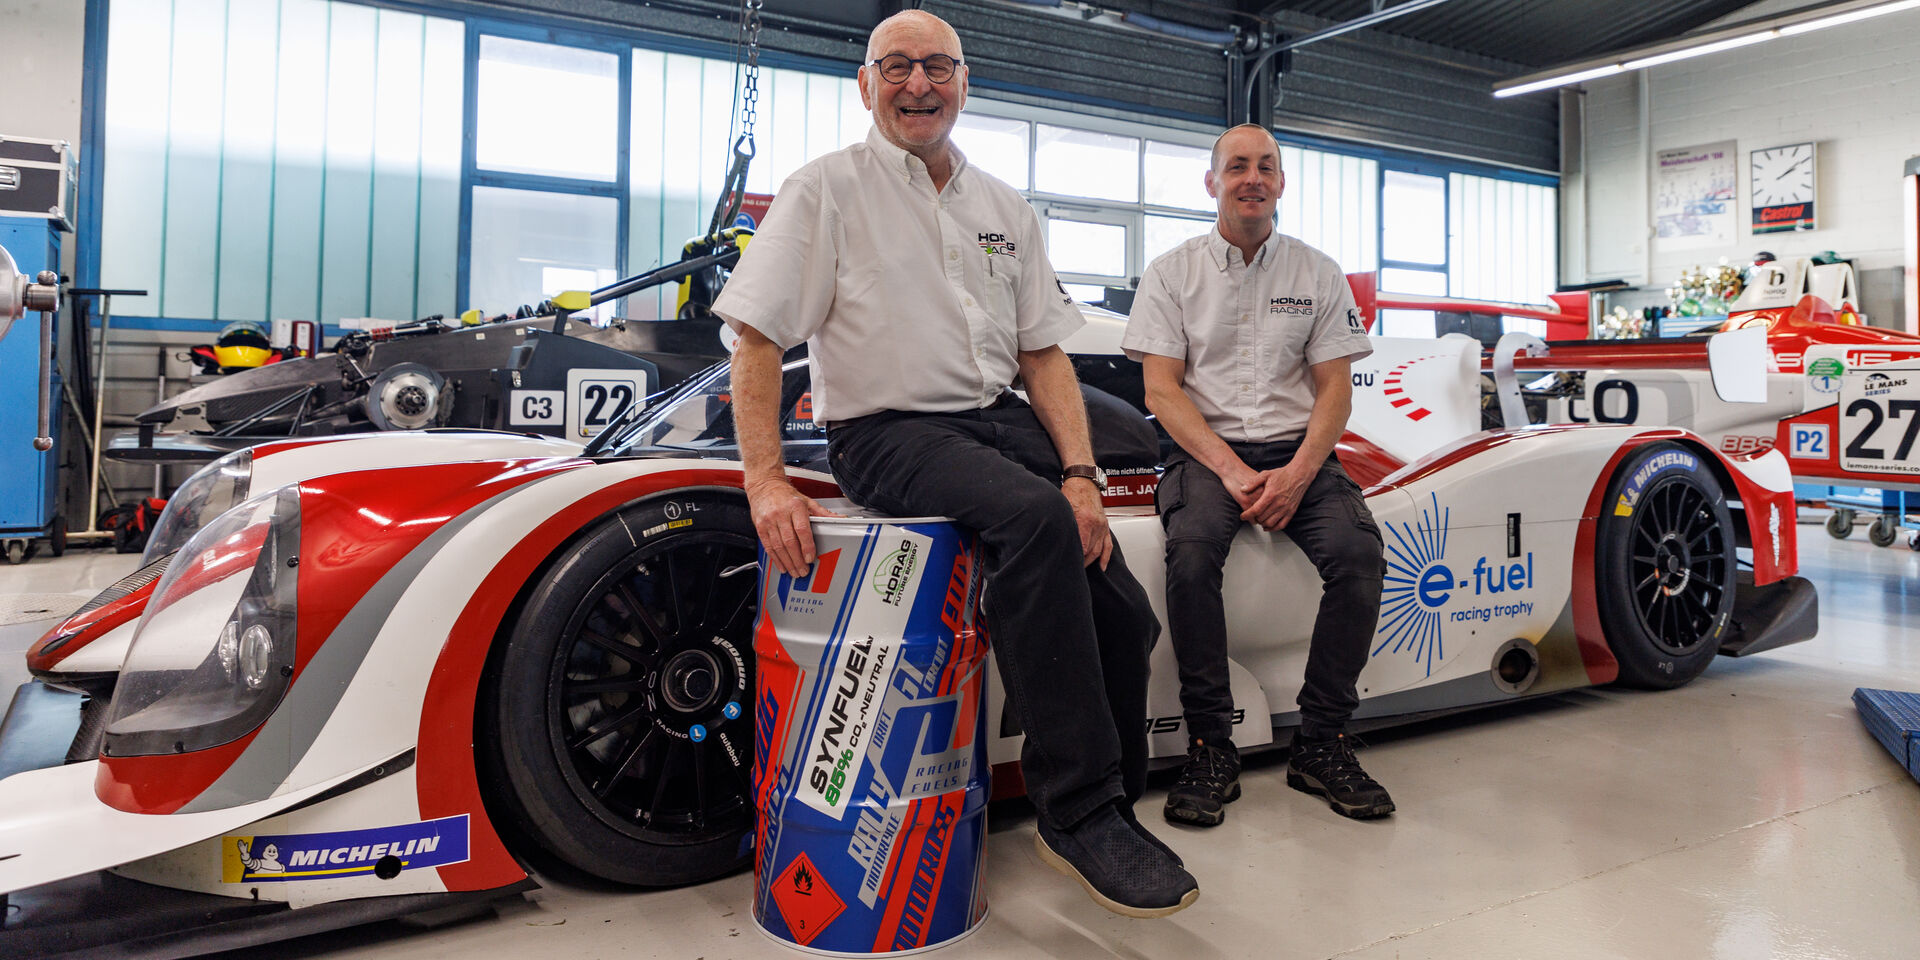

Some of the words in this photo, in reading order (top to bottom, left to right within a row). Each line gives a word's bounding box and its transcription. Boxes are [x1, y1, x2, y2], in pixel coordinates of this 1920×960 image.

[1760, 204, 1804, 221] Castrol
[978, 233, 1016, 251] HORG
[1270, 297, 1313, 306] HORAG
[1270, 307, 1313, 316] RACING
[1864, 383, 1874, 391] LE
[1878, 379, 1908, 389] MANS
[1865, 388, 1891, 397] SERIES
[522, 396, 553, 419] C3
[584, 384, 633, 426] 22
[1845, 398, 1920, 461] 27
[1720, 434, 1776, 455] BBS
[1795, 430, 1824, 453] P2
[1105, 468, 1120, 476] Bitte
[1120, 467, 1136, 475] nicht
[1634, 452, 1693, 488] MICHELIN
[1846, 462, 1920, 472] lemans-series.co
[685, 502, 700, 512] FL
[882, 539, 911, 604] HORAG
[894, 576, 908, 607] FUTURE
[905, 543, 919, 575] ENERGY
[1419, 552, 1533, 607] e-fuel
[1450, 606, 1491, 622] racing
[1494, 600, 1534, 618] trophy
[923, 635, 948, 694] CIRCUIT
[810, 634, 874, 795] SYNFUEL
[656, 718, 689, 739] RACING
[872, 707, 892, 750] DRIFT
[719, 732, 741, 767] autobau
[825, 749, 854, 807] 85%
[916, 757, 969, 777] RACING
[911, 775, 958, 793] FUELS
[848, 772, 889, 870] RALLY
[288, 835, 441, 867] MICHELIN
[866, 811, 901, 892] MOTORCYCLE
[799, 920, 805, 930] 3
